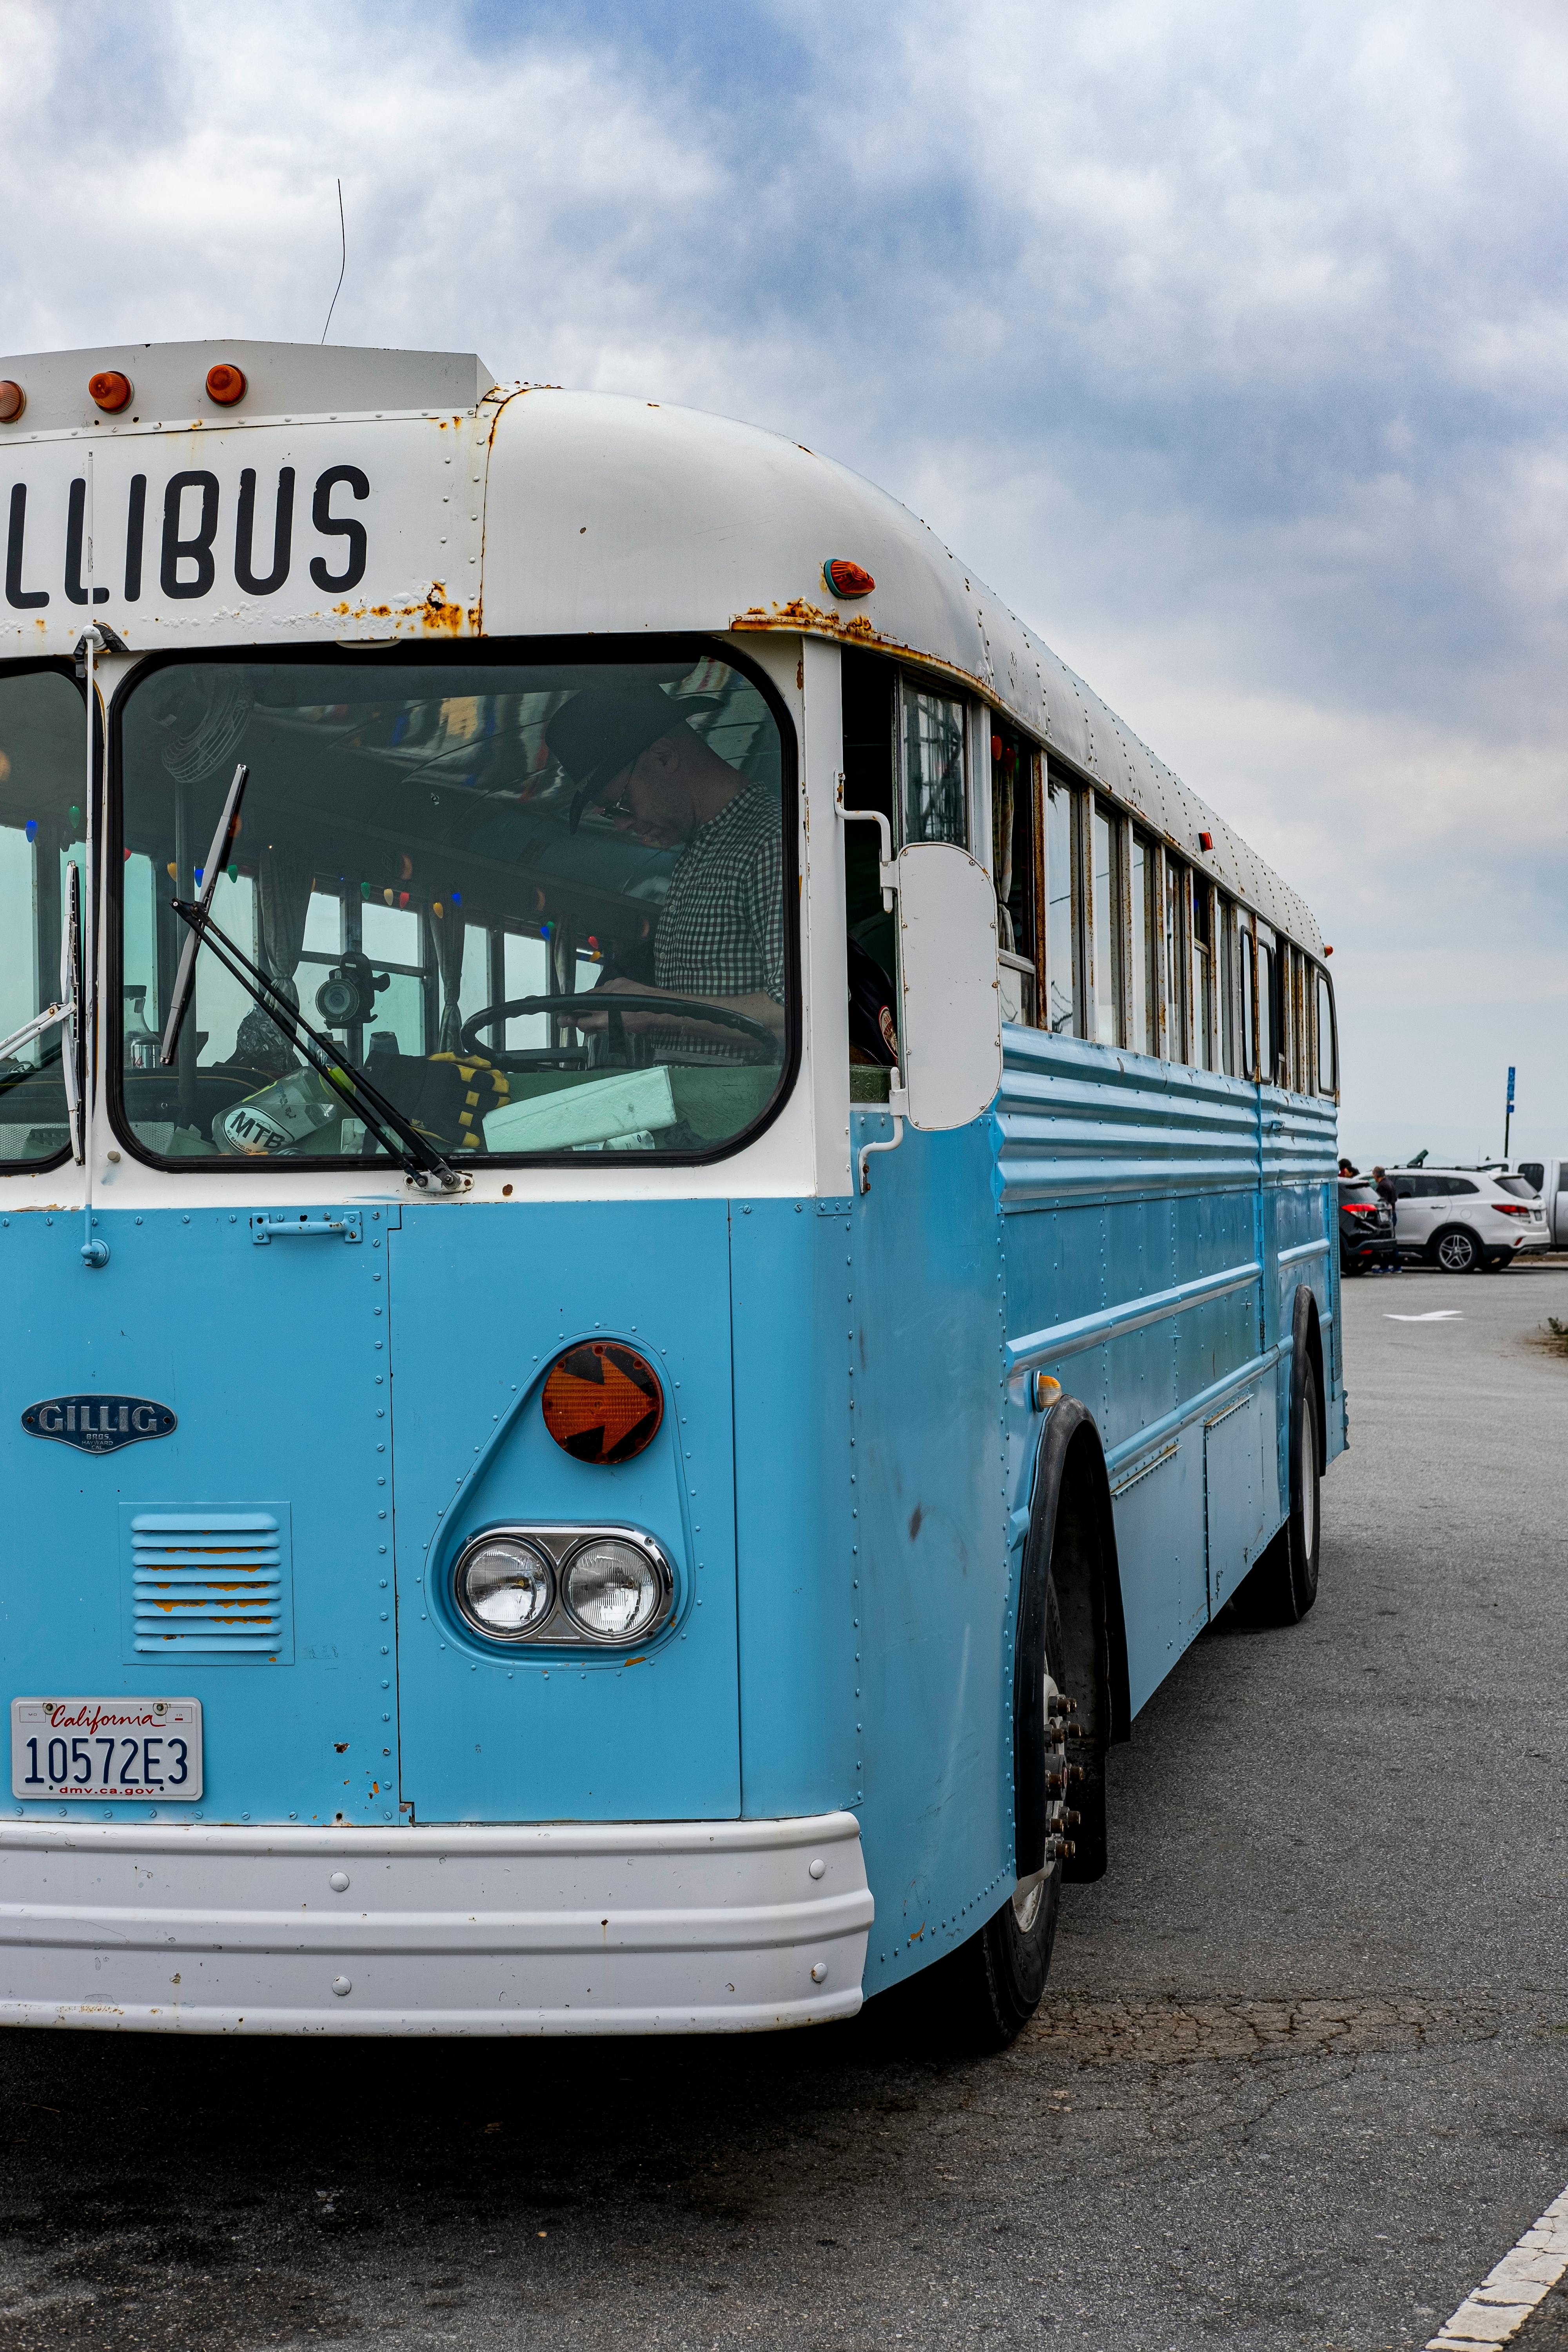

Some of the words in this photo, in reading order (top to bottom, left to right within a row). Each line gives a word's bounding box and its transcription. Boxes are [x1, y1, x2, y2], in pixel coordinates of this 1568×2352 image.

[5, 465, 370, 609] LLIBUS
[230, 1111, 285, 1149] MTB
[230, 1136, 252, 1153] BACHELOR
[39, 1406, 157, 1432] GILLIG
[51, 1705, 166, 1735] California
[25, 1738, 187, 1784] 10572E3
[59, 1786, 154, 1795] dmv.ca.gov
